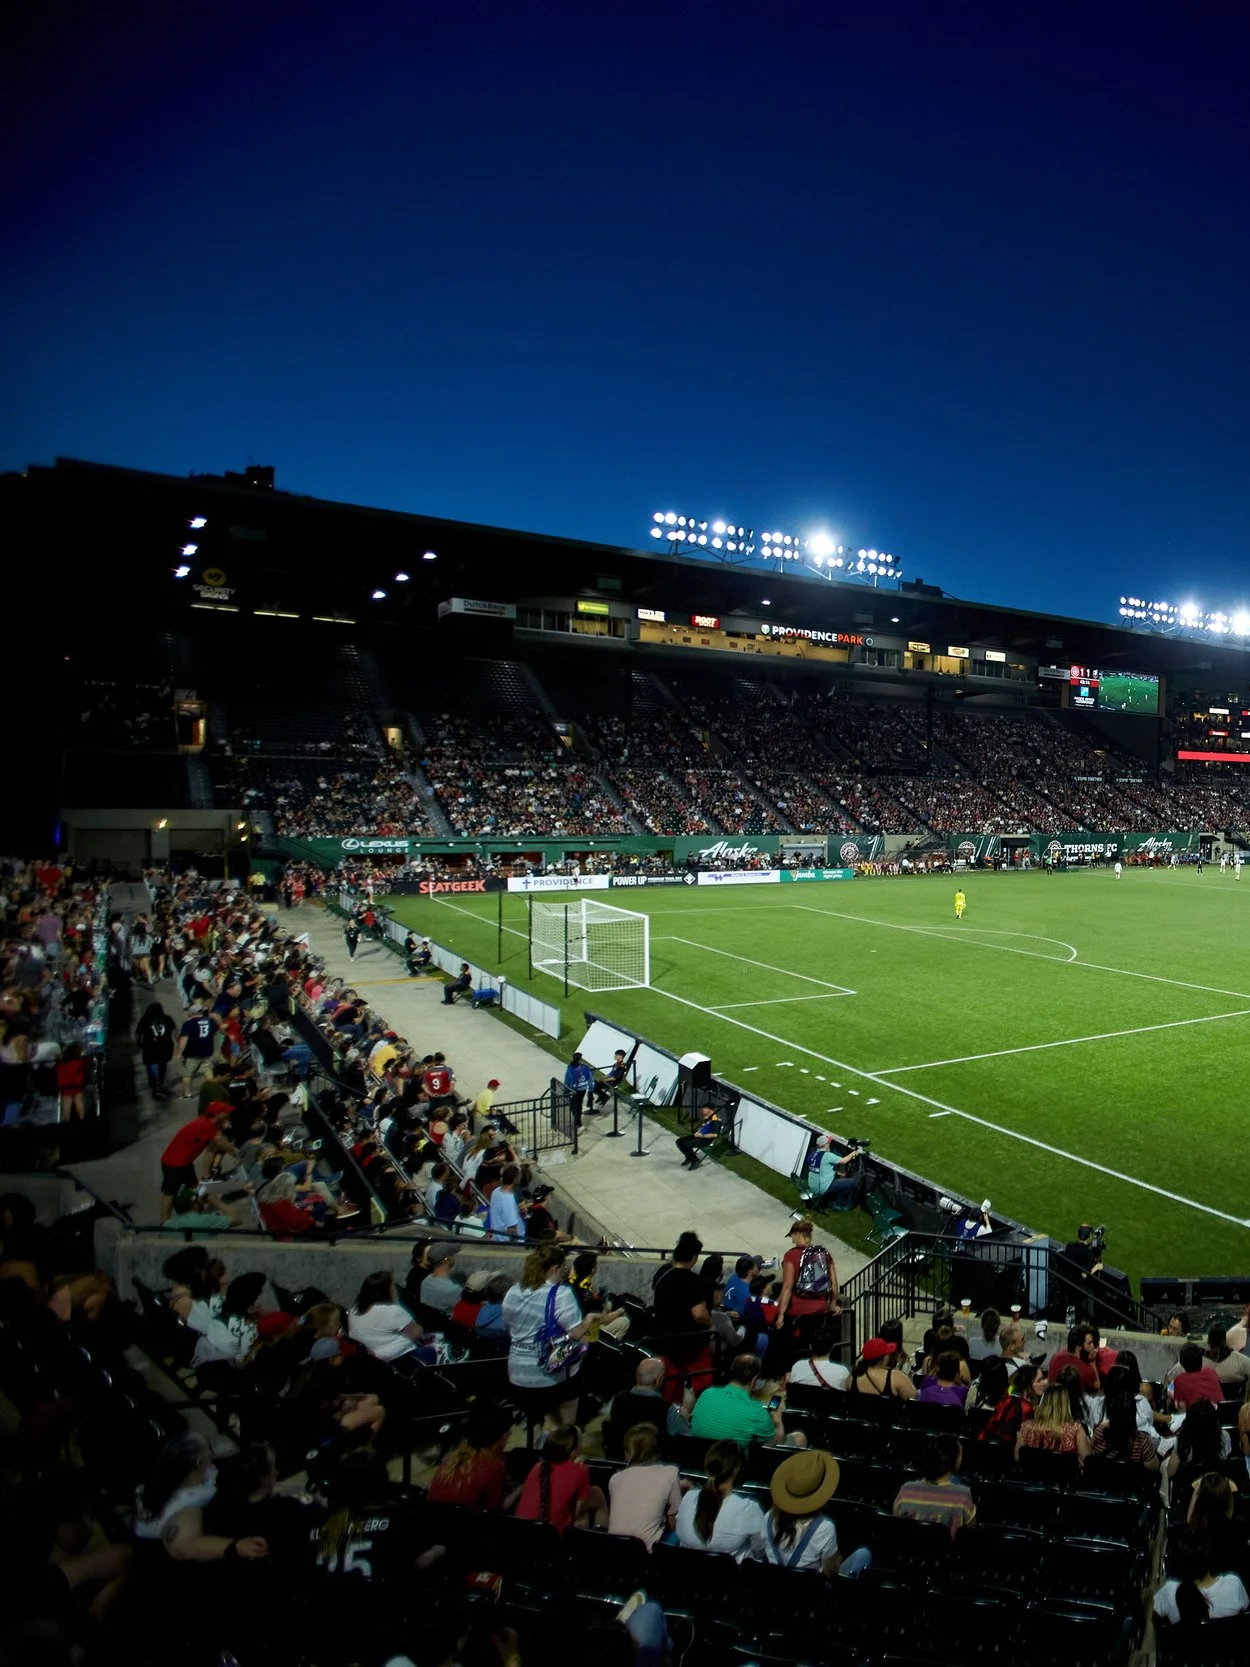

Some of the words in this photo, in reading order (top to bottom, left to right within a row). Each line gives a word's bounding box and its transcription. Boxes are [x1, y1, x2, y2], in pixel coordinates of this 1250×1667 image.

[1080, 668, 1085, 677] 1
[699, 841, 758, 858] Alaska
[1064, 844, 1105, 853] THORNS
[1107, 843, 1117, 852] FC
[1137, 837, 1172, 852] Alaska
[419, 880, 486, 894] SEATGEEK
[533, 878, 594, 886] PROVIDENCE
[612, 876, 637, 886] POWER
[637, 876, 647, 885] UP
[199, 1024, 209, 1038] 13
[432, 1078, 441, 1090] 9
